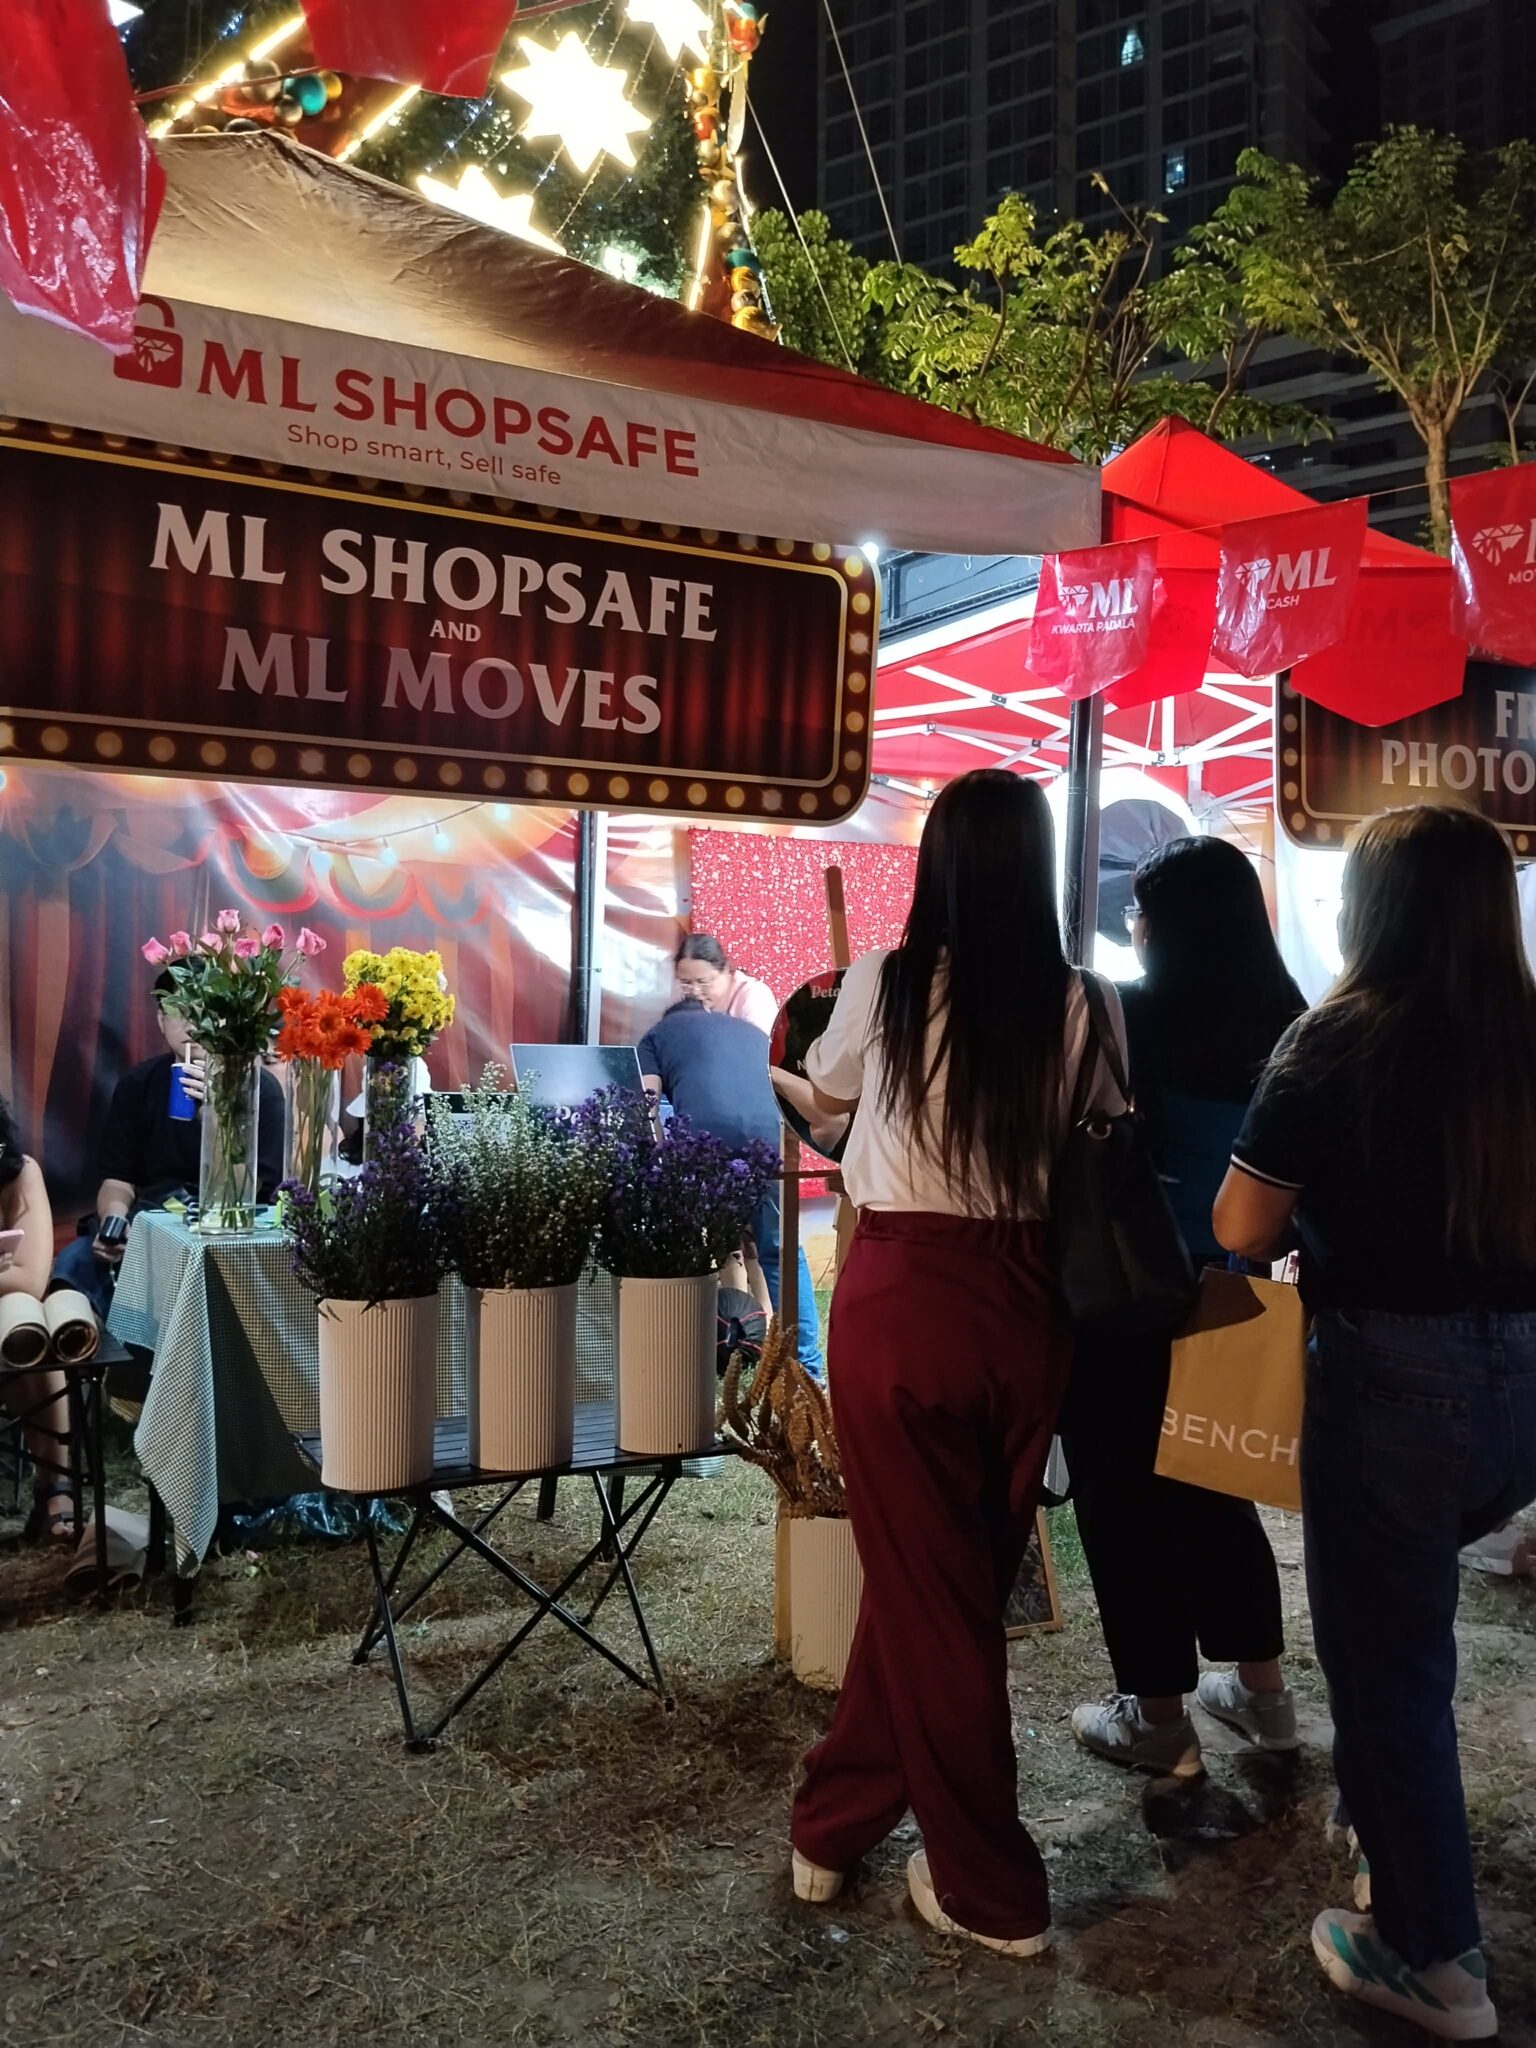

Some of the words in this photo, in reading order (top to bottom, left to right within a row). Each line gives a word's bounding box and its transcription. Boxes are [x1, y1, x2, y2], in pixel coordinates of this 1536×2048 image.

[197, 340, 317, 413] ML
[334, 368, 700, 477] SHOPSAFE
[288, 424, 358, 454] Shop
[367, 440, 452, 470] smart,
[460, 452, 503, 474] Sell
[512, 463, 562, 485] safe
[149, 502, 286, 585] ML
[320, 529, 718, 642] SHOPSAFE
[1088, 577, 1139, 619] ML
[1268, 546, 1337, 594] ML
[1508, 568, 1536, 585] MO
[429, 619, 482, 643] AND
[1051, 622, 1095, 635] KWARTA
[1096, 618, 1136, 632] PADALA
[217, 626, 348, 703] ML
[381, 647, 662, 734] MOVES
[1381, 739, 1536, 795] PHOTO
[1161, 1405, 1299, 1466] BENCH
